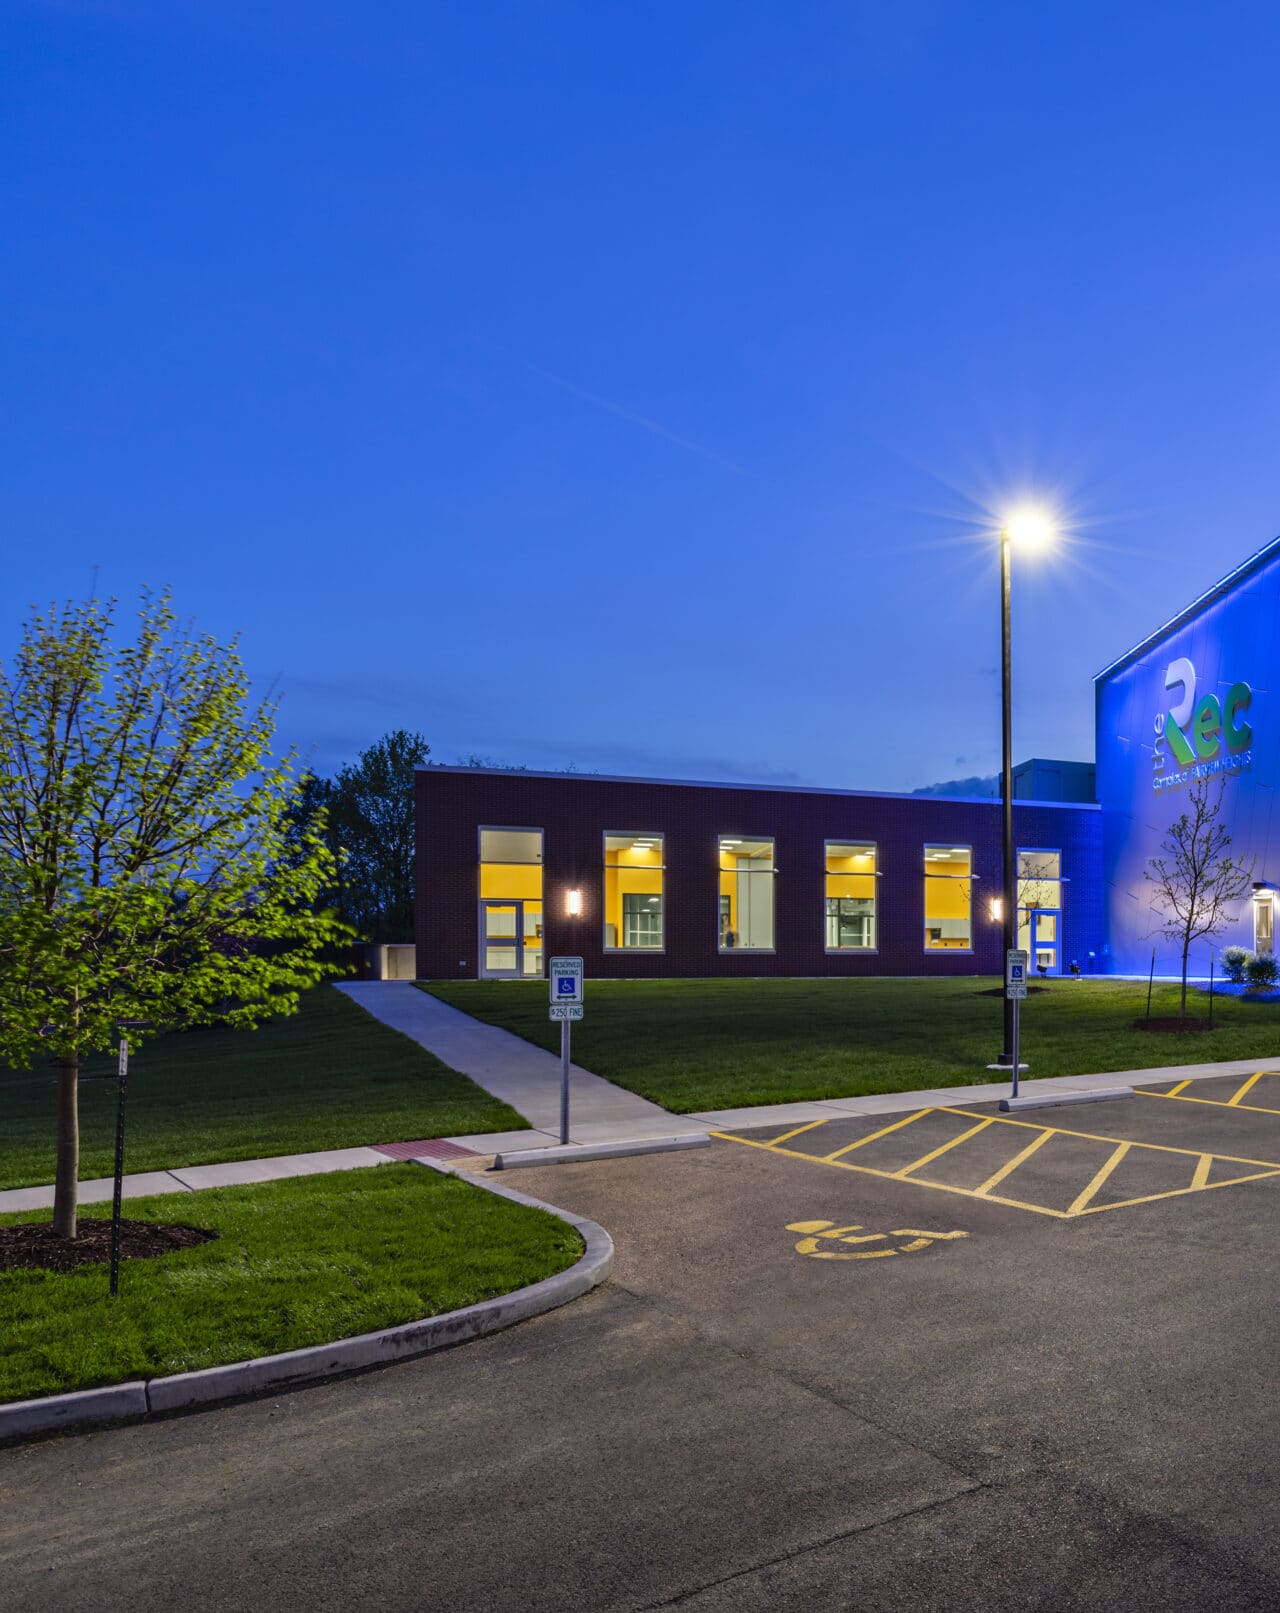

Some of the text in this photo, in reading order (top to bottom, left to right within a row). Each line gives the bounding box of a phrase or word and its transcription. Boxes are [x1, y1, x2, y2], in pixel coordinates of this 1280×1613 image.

[1165, 657, 1252, 765] Rec
[1152, 713, 1164, 770] the
[551, 1007, 582, 1017] $250 FINE
